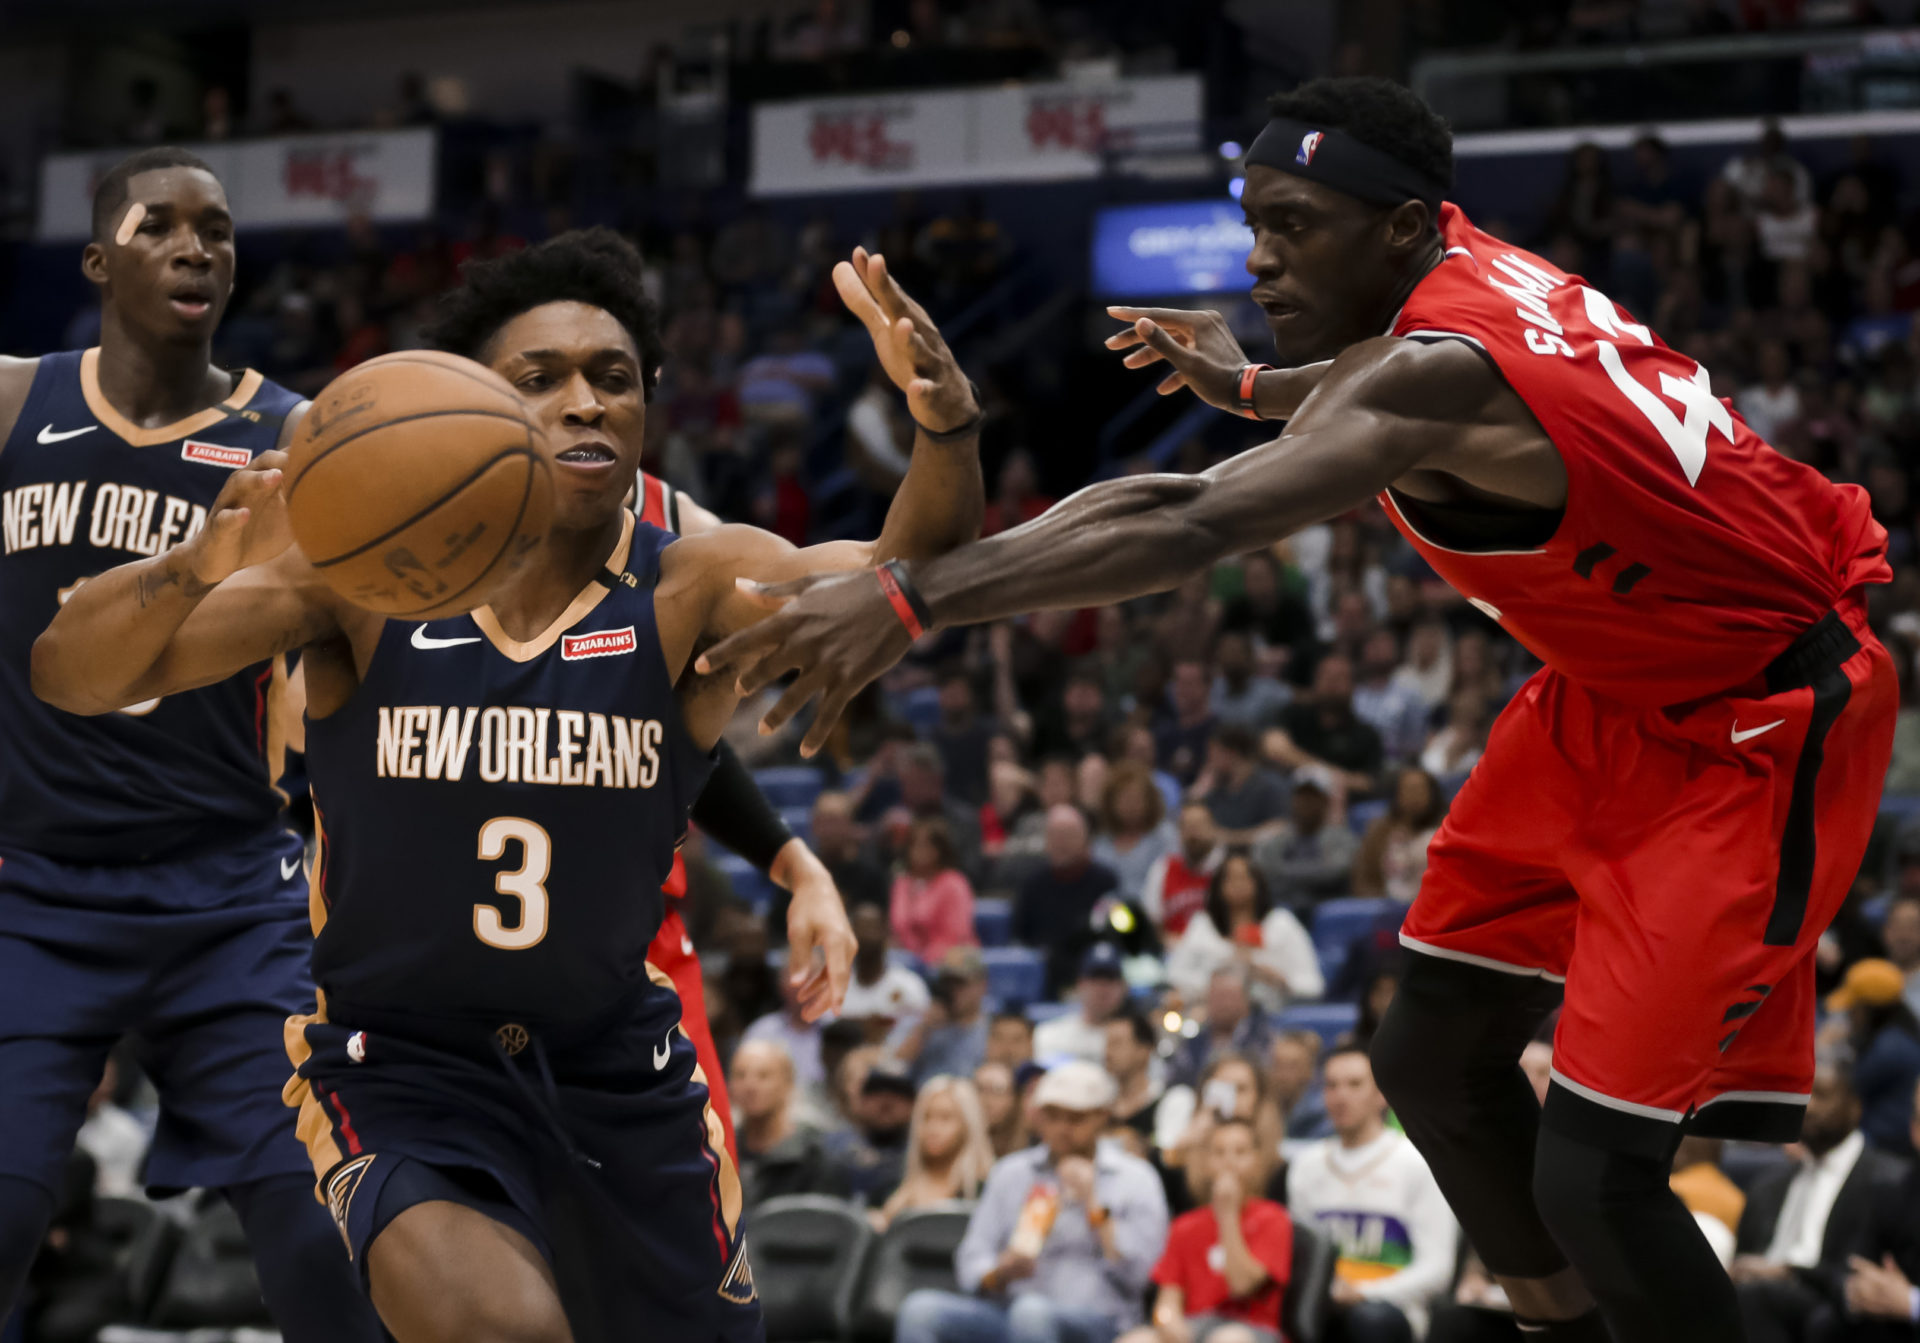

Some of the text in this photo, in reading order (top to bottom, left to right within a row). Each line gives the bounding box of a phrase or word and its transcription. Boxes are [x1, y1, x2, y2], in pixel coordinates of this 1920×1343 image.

[3, 480, 87, 556] NEW
[376, 706, 663, 788] NEW ORLEANS
[473, 816, 552, 950] 3
